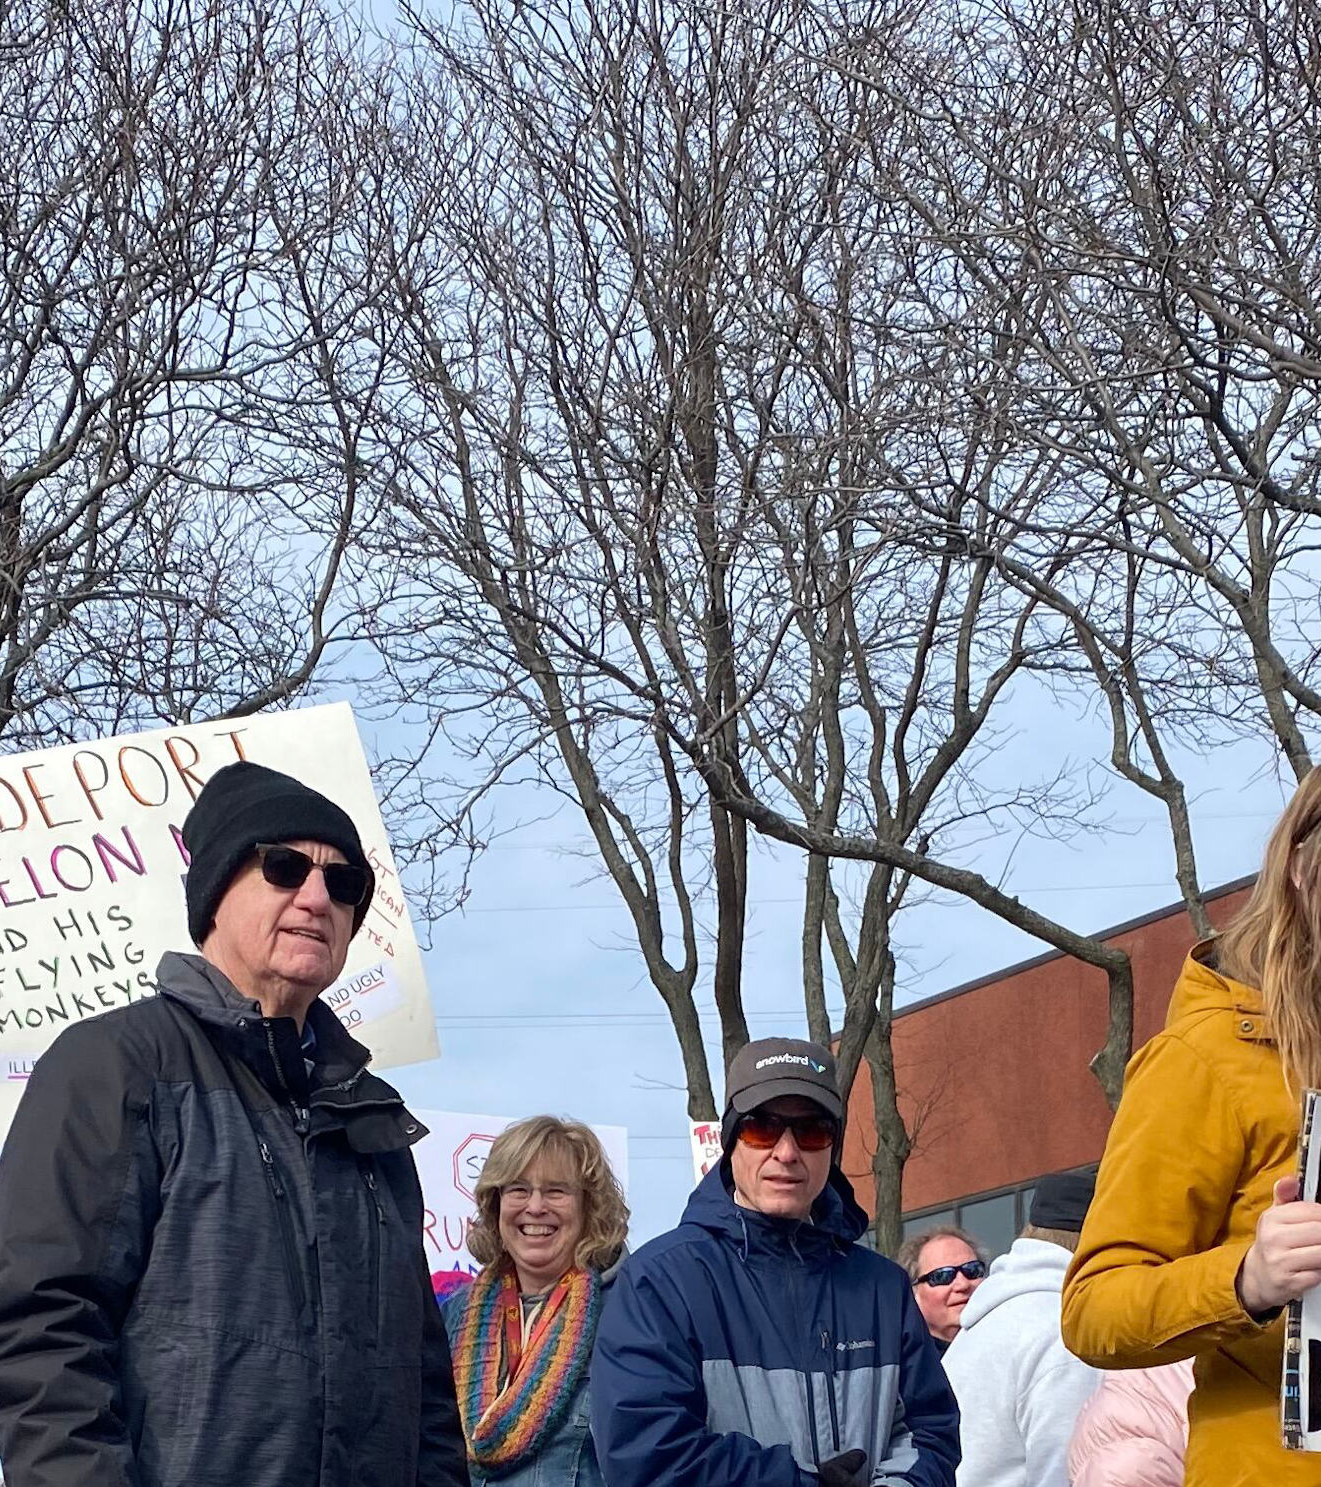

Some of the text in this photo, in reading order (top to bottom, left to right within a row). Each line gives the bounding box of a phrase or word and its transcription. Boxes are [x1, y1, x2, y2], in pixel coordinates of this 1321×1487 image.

[53, 905, 133, 942] HIS
[353, 965, 385, 994] UGLY
[755, 1053, 809, 1070] snowbird
